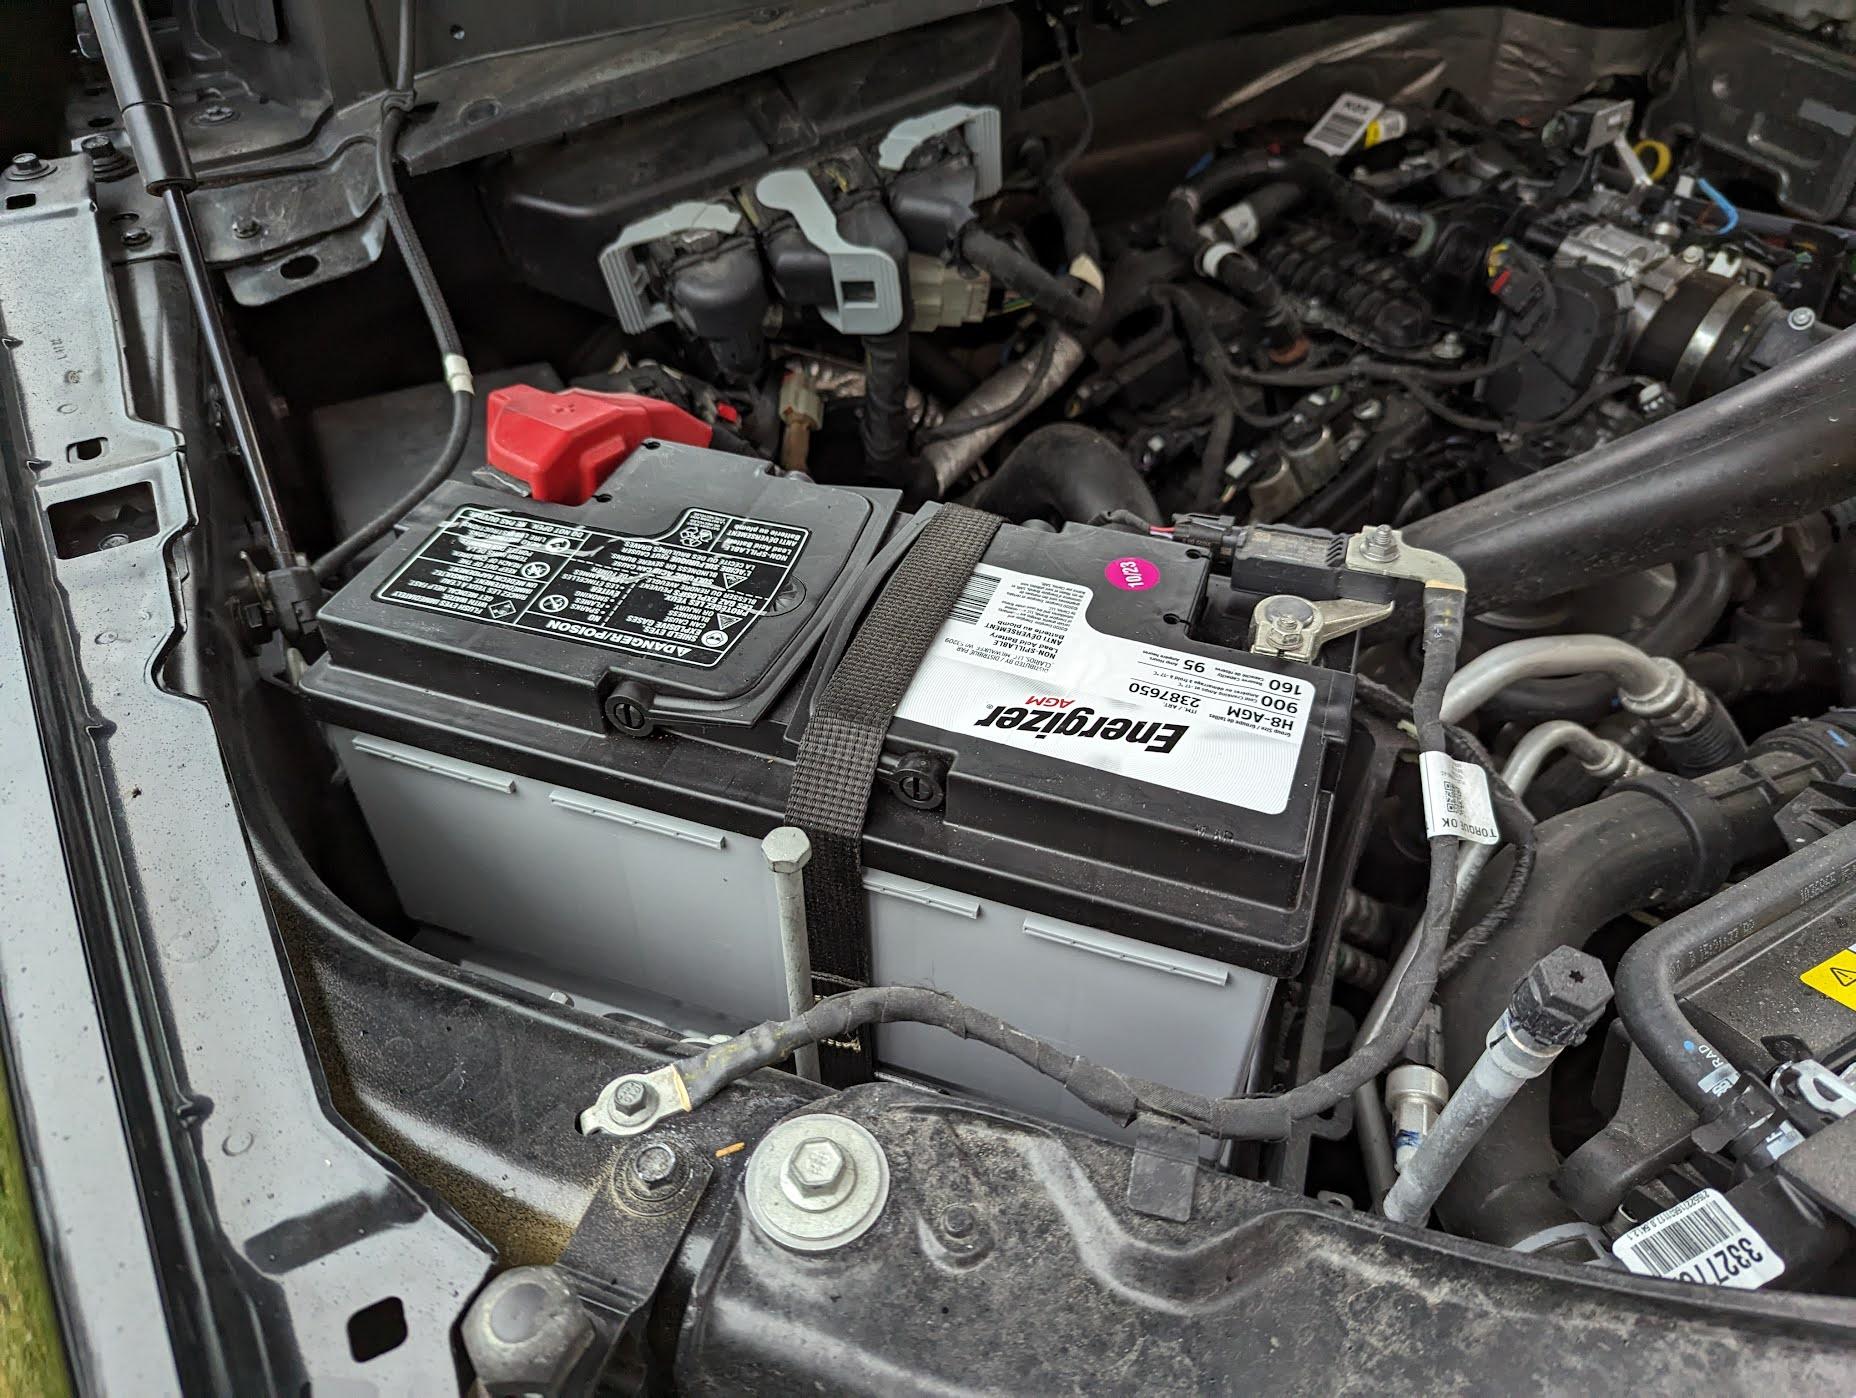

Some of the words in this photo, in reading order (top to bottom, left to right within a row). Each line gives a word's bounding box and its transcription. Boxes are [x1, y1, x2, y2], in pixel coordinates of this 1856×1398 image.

[499, 517, 517, 525] PAS
[732, 522, 759, 532] plomb
[527, 534, 547, 542] LIRE
[767, 530, 801, 540] Batterie
[777, 538, 797, 546] ANTI
[620, 547, 651, 556] CAUSER
[723, 544, 788, 561] NON-SPILLABLE
[771, 546, 792, 554] Lead
[649, 552, 670, 560] PEUT
[497, 559, 523, 568] REACH
[611, 560, 637, 569] CAUSE
[635, 557, 665, 567] SEVERE
[668, 555, 720, 569] SULFURIQUE
[497, 566, 518, 574] KEEP
[635, 564, 653, 572] CAN
[675, 565, 718, 577] BLINDNESS
[430, 569, 474, 581] CONSULTEZ
[1120, 562, 1144, 588] 10/23
[426, 583, 447, 591] HELP
[465, 583, 488, 591] YEUX
[638, 582, 673, 593] PEUVENT
[678, 584, 710, 594] RENDRE
[444, 587, 479, 598] MEDICAL
[476, 593, 495, 601] GET
[499, 590, 529, 600] RINCEZ
[572, 590, 610, 601] SMOKING
[671, 589, 719, 602] EXPLOSIFS
[466, 598, 489, 607] WITH
[573, 597, 605, 607] FLAMES
[687, 599, 705, 607] LES
[717, 598, 737, 606] GAZ
[721, 592, 758, 604] BLESSER
[437, 599, 459, 608] EYES
[455, 603, 484, 613] FLUSH
[568, 603, 601, 613] SPARKS
[735, 602, 754, 610] LES
[586, 614, 602, 622] NO
[624, 614, 656, 625] GASES
[661, 615, 689, 625] CAUSE
[666, 609, 711, 622] BLINDNESS
[653, 620, 703, 635] EXPLOSIVE
[688, 620, 707, 628] CAN
[996, 618, 1021, 629] plomb
[542, 619, 678, 653] DANGER/POISON
[665, 630, 698, 642] SHIELD
[983, 621, 1041, 641] DÉVERSEMENT
[1033, 628, 1064, 639] Batterie
[989, 631, 1018, 643] Battery
[1042, 636, 1062, 645] ANTI
[1019, 639, 1037, 648] Acid
[1038, 643, 1058, 653] Lead
[992, 638, 1056, 660] NON-SPILLABLE
[1182, 658, 1206, 673] 95
[1267, 677, 1304, 697] 160
[1127, 681, 1201, 708] 2387650
[1025, 695, 1074, 708] AGM
[1259, 694, 1299, 714] 900
[1226, 704, 1293, 731] H8-AGM
[973, 705, 1189, 753] Energizer
[1273, 729, 1290, 737] Group
[1442, 818, 1458, 828] OK
[1460, 821, 1496, 838] TORQUE
[1698, 1045, 1724, 1068] RAD
